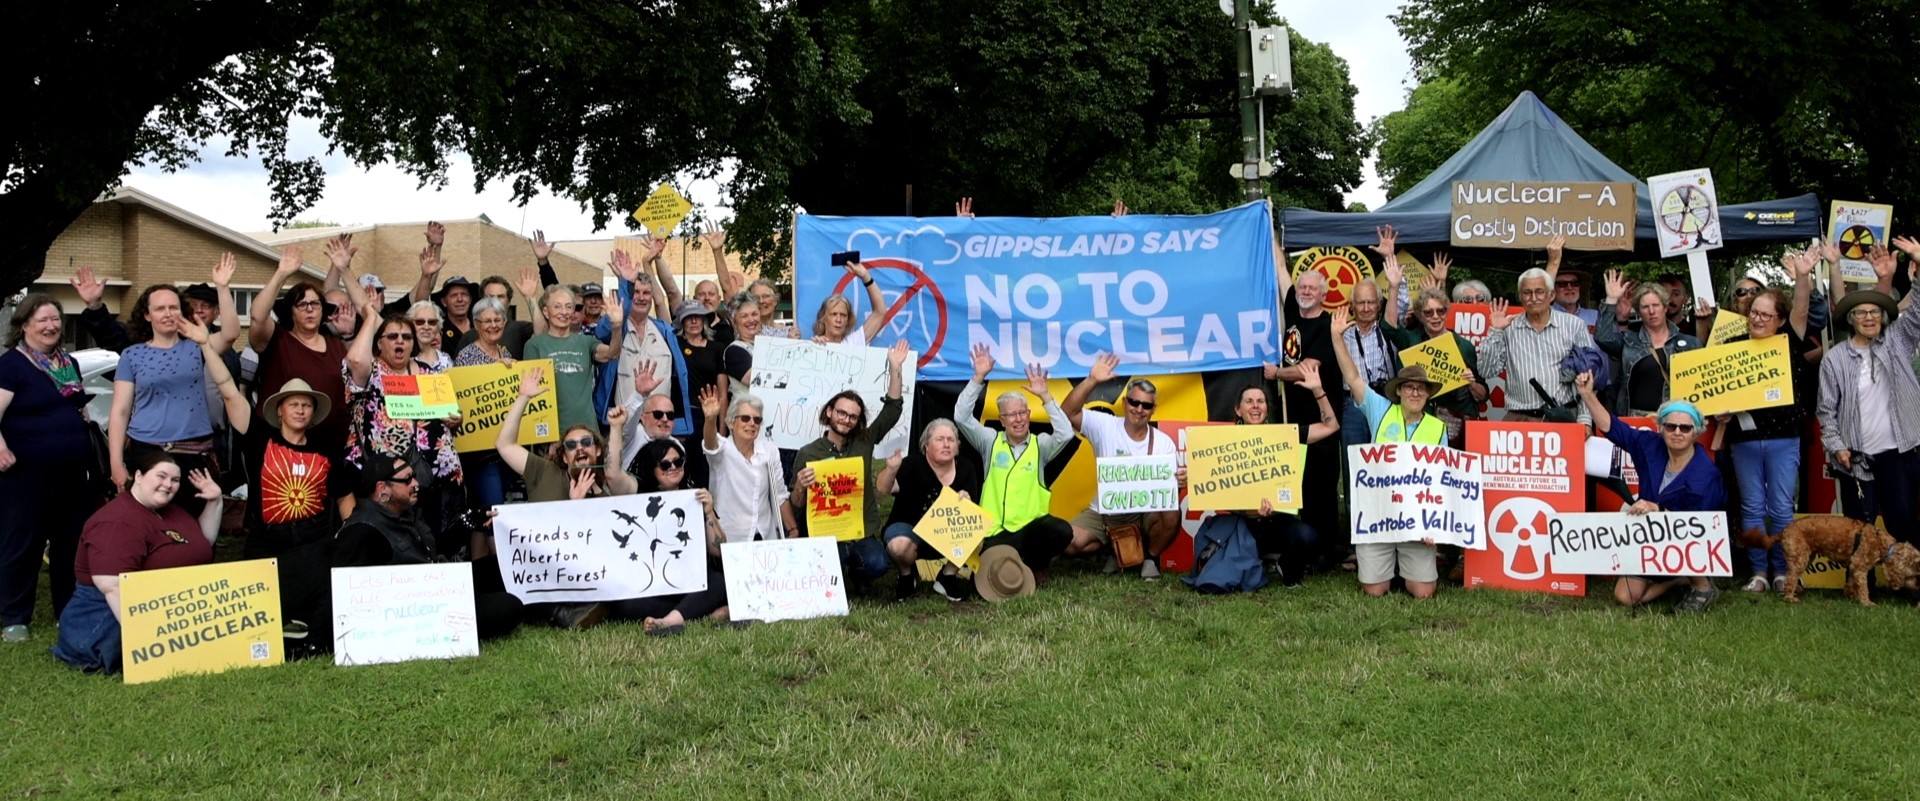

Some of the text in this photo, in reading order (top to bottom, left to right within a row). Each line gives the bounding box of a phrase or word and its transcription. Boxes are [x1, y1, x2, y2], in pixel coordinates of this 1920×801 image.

[1457, 182, 1571, 205] Nuclear
[1596, 185, 1617, 207] A
[1454, 214, 1626, 244] Costly Distraction
[963, 227, 1222, 260] GIPPSLAND SAYS
[1296, 252, 1317, 277] EEP
[964, 269, 1169, 320] NO TO
[1454, 312, 1486, 335] NO
[967, 308, 1277, 369] NUCLEAR
[1420, 344, 1450, 361] JOBS
[1430, 358, 1465, 375] NOW!
[1431, 368, 1461, 383] NUCLEAR
[1675, 350, 1749, 380] PROTECT OUR
[1701, 349, 1782, 380] FOOD, WATER,
[456, 374, 520, 400] ROTECT OUR
[1428, 372, 1448, 385] LATER
[1694, 363, 1768, 391] AND HEALTH.
[1702, 368, 1785, 400] NUCLEAR.
[476, 386, 509, 405] FOOD,
[470, 402, 492, 418] AND
[453, 422, 476, 438] NO
[1192, 443, 1238, 460] PROTECT
[1240, 436, 1264, 450] OUR
[1217, 442, 1294, 465] FOOD, WATER,
[1489, 430, 1561, 456] NO TO
[292, 462, 306, 476] NO
[1210, 455, 1280, 477] AND HEALTH.
[1360, 444, 1478, 473] WE WANT
[1483, 455, 1568, 476] NUCLEAR
[1098, 464, 1172, 483] RENEWABLES
[1194, 464, 1296, 496] NO NUCLEAR.
[1355, 468, 1480, 501] Renewable Energy
[1102, 490, 1128, 510] CAN
[1129, 489, 1150, 508] DO
[1392, 488, 1444, 505] in the
[930, 506, 961, 518] JOBS
[947, 514, 983, 526] NOW!
[509, 526, 594, 546] Friends of
[950, 525, 984, 533] NUCLEAR
[952, 532, 973, 540] LATER
[1356, 508, 1476, 545] Latrobe Valley
[1549, 514, 1706, 556] Renewables
[512, 548, 579, 566] Alberton
[752, 551, 779, 571] NO
[1640, 538, 1731, 574] ROCK
[513, 565, 608, 585] West Forest
[1804, 562, 1827, 575] NO
[128, 578, 230, 617] PROTECT OUR
[166, 582, 270, 620] FOOD, WATER,
[156, 600, 253, 637] AND HEALTH.
[384, 602, 448, 621] nuclear
[131, 610, 276, 665] NO NUCLEAR.
